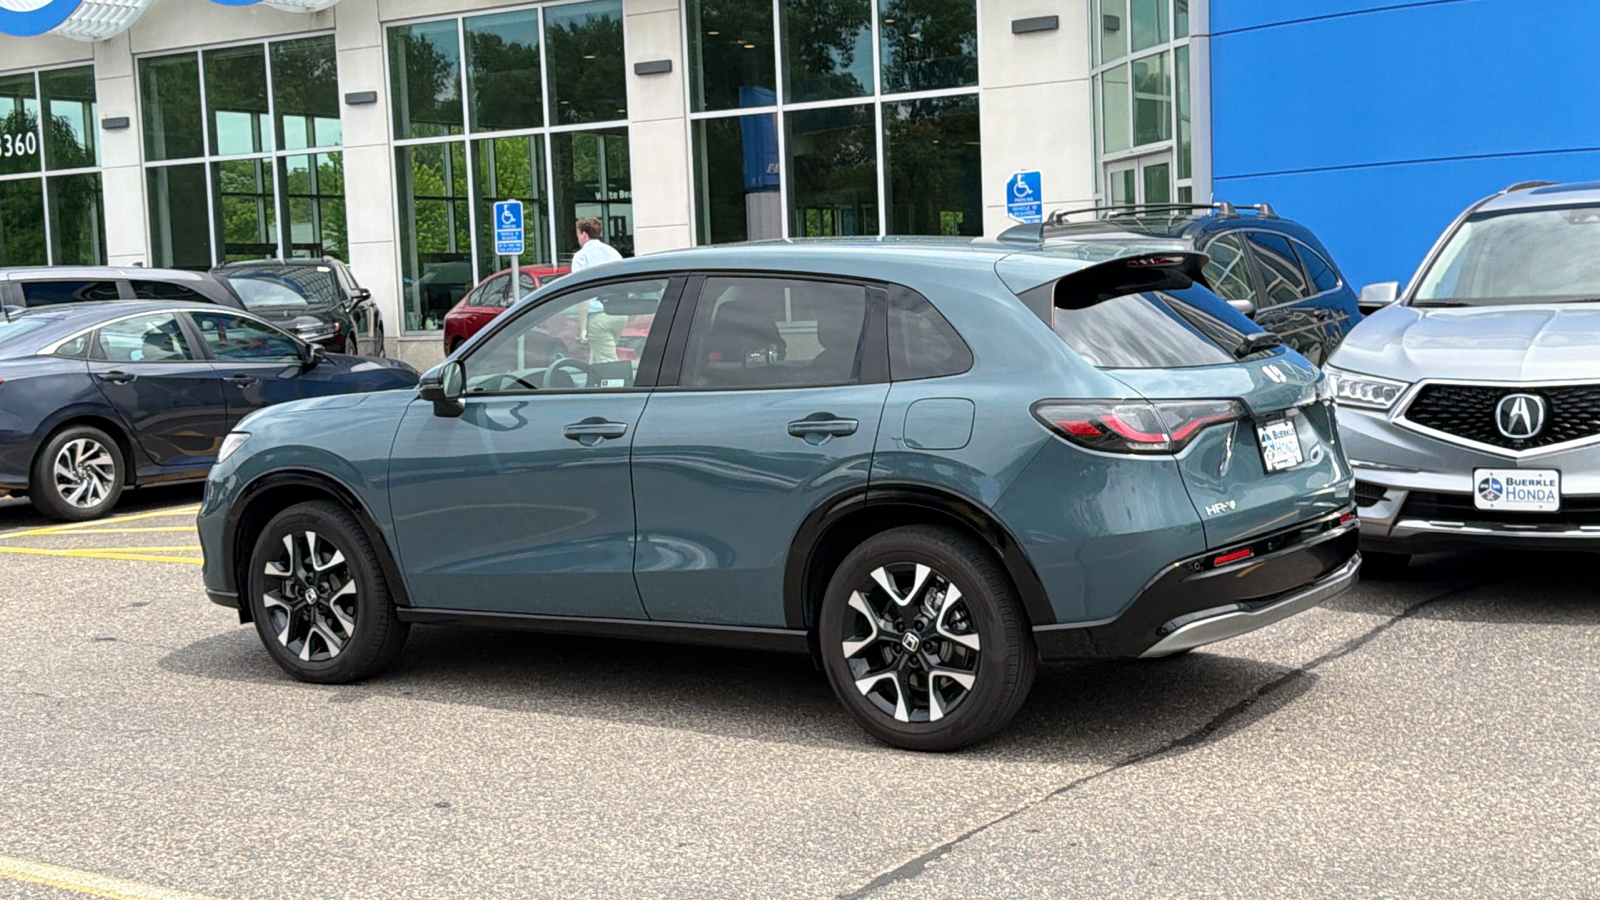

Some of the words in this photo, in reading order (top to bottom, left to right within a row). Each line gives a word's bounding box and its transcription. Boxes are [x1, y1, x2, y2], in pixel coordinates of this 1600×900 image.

[0, 131, 36, 158] 360
[1506, 477, 1556, 487] BUERKLE
[1506, 487, 1556, 501] HONDA
[1205, 500, 1236, 516] HR-V
